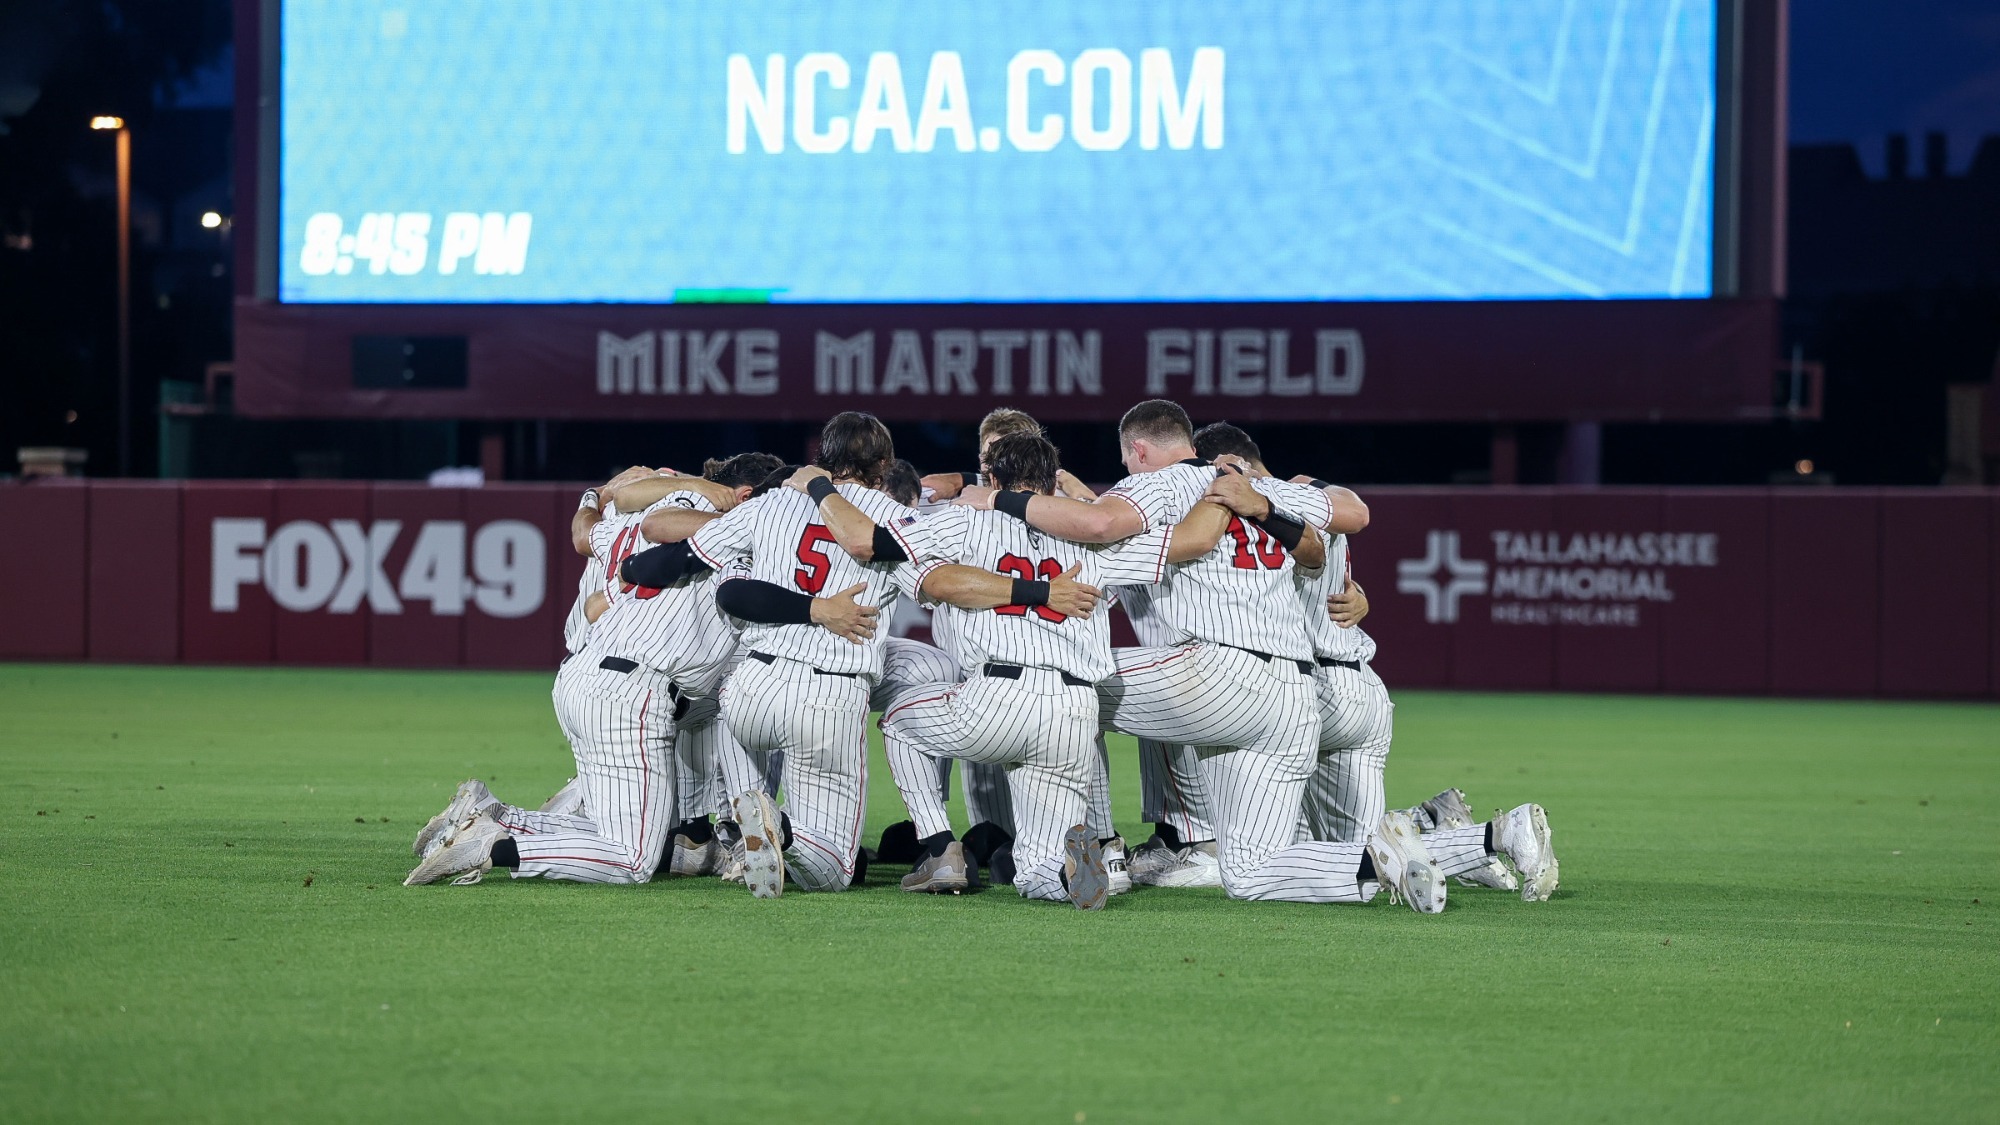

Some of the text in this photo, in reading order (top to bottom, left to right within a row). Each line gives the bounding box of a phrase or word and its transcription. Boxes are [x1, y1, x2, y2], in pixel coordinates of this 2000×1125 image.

[726, 47, 1226, 155] NCAA.COM
[300, 212, 533, 275] 8:45 PM
[597, 328, 1365, 396] MIKE MARTIN FIELD
[211, 517, 546, 618] FOX49
[794, 522, 838, 596] 5
[1492, 530, 1717, 565] TALLAHASSEE
[1492, 567, 1674, 601] MEMORIAL
